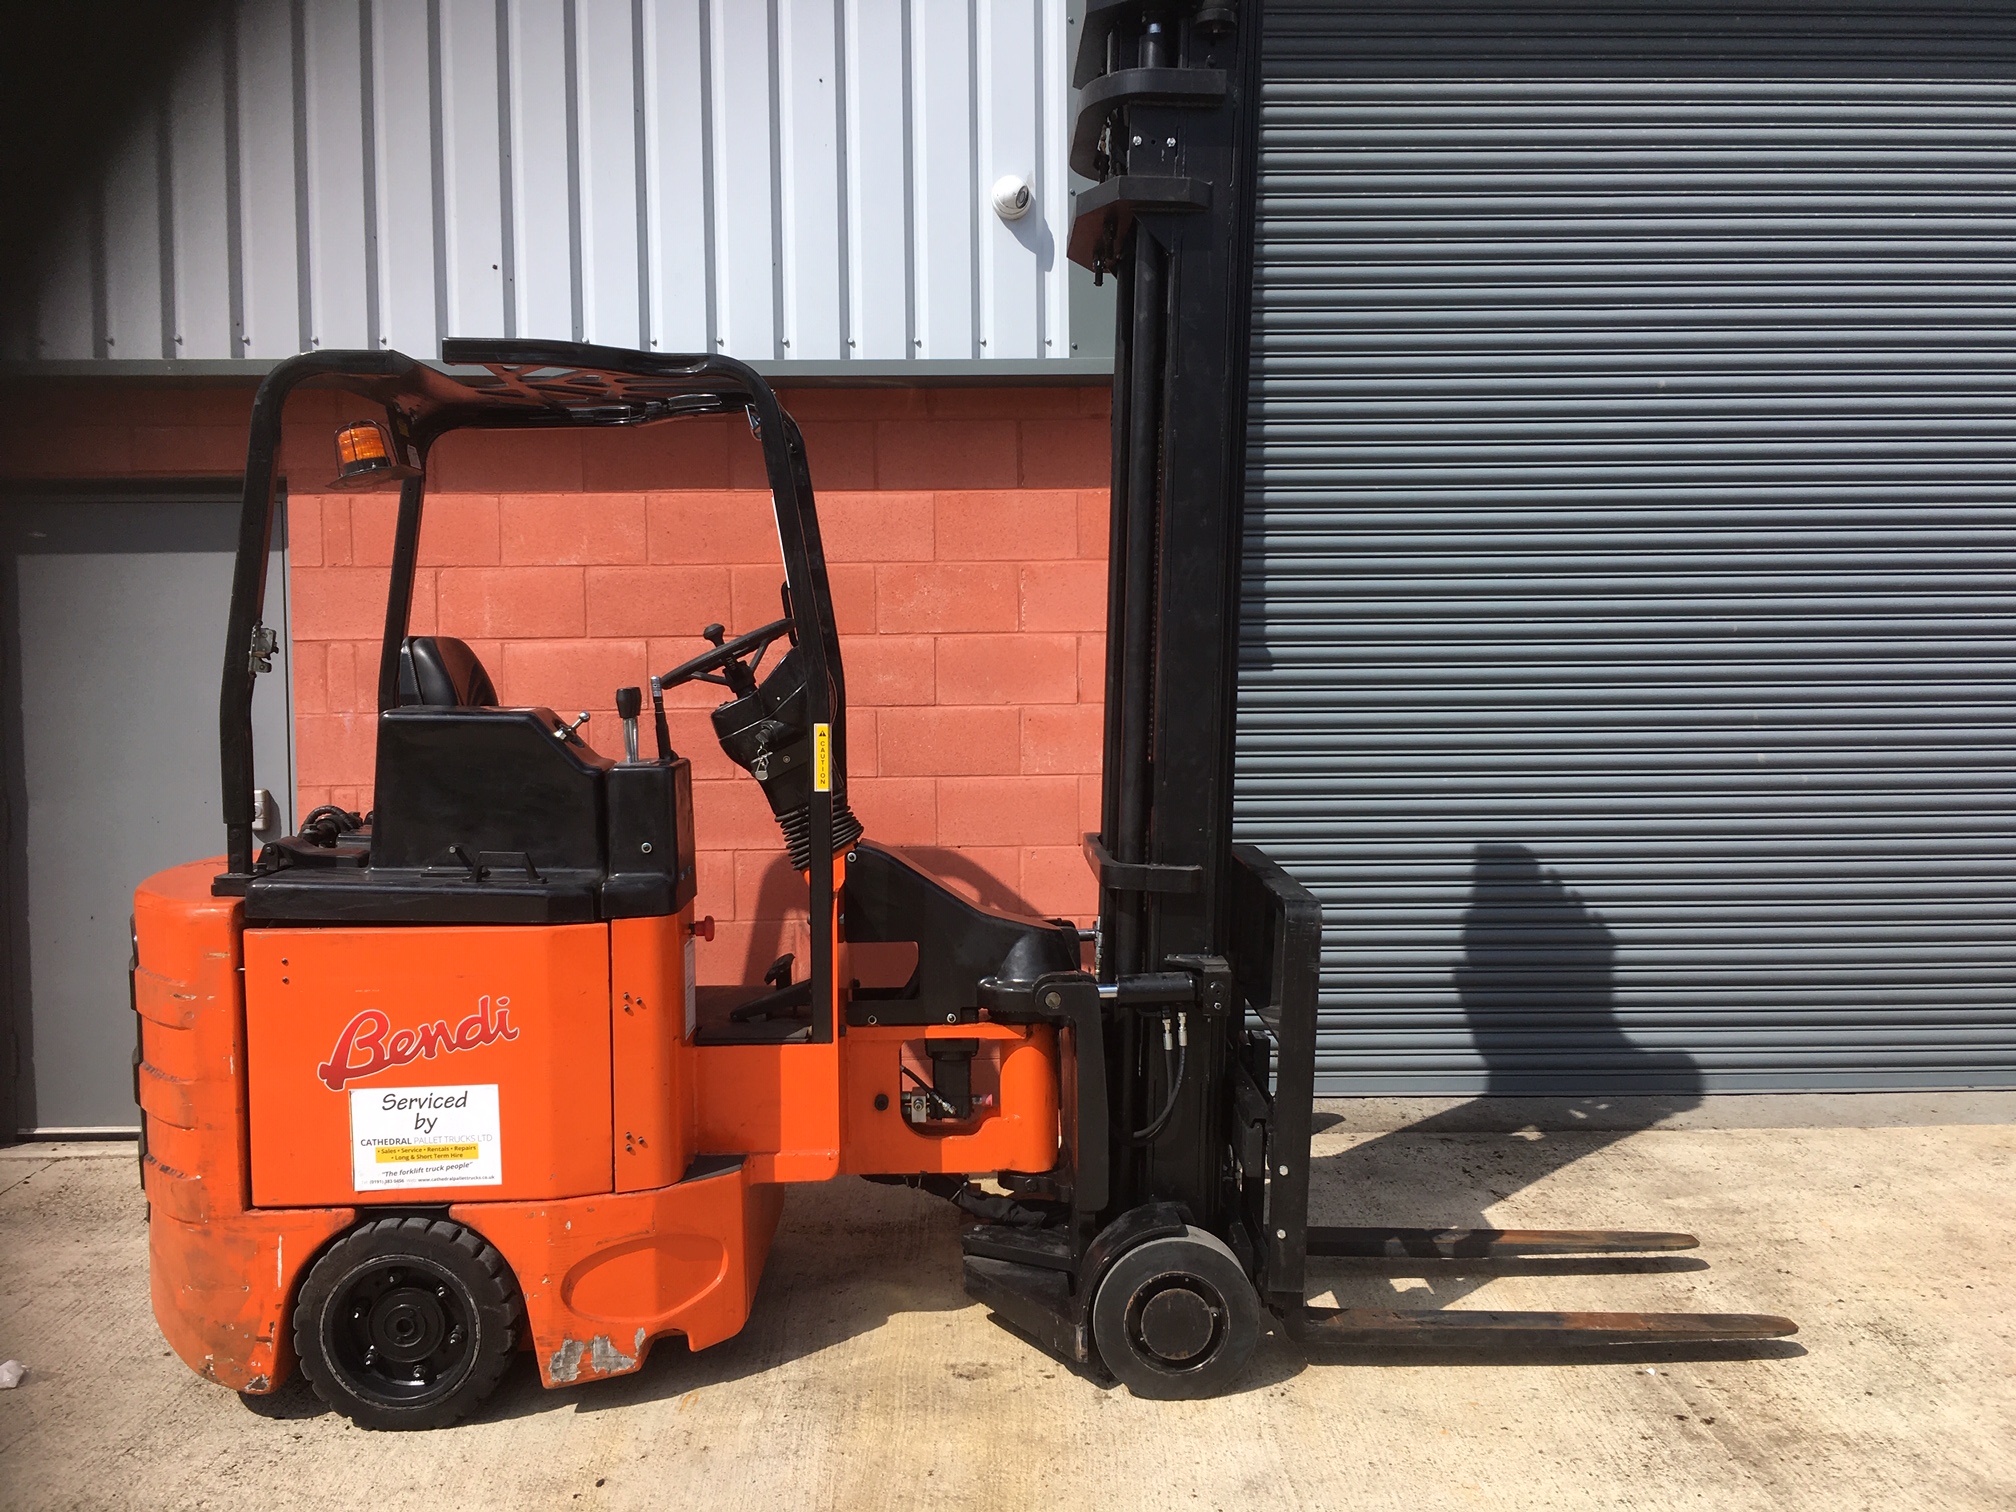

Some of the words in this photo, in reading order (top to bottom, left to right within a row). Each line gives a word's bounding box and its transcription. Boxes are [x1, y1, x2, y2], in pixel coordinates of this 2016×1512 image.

[317, 995, 519, 1090] Bendi
[382, 1090, 468, 1111] Serviced
[414, 1112, 438, 1134] by
[360, 1138, 412, 1147] CATHEDRAL
[413, 1135, 442, 1144] PALLET
[444, 1134, 476, 1142] TRUCKS
[477, 1133, 493, 1142] LTD
[454, 1144, 477, 1152] Repairs
[399, 1167, 424, 1176] forklift
[426, 1165, 445, 1174] truck
